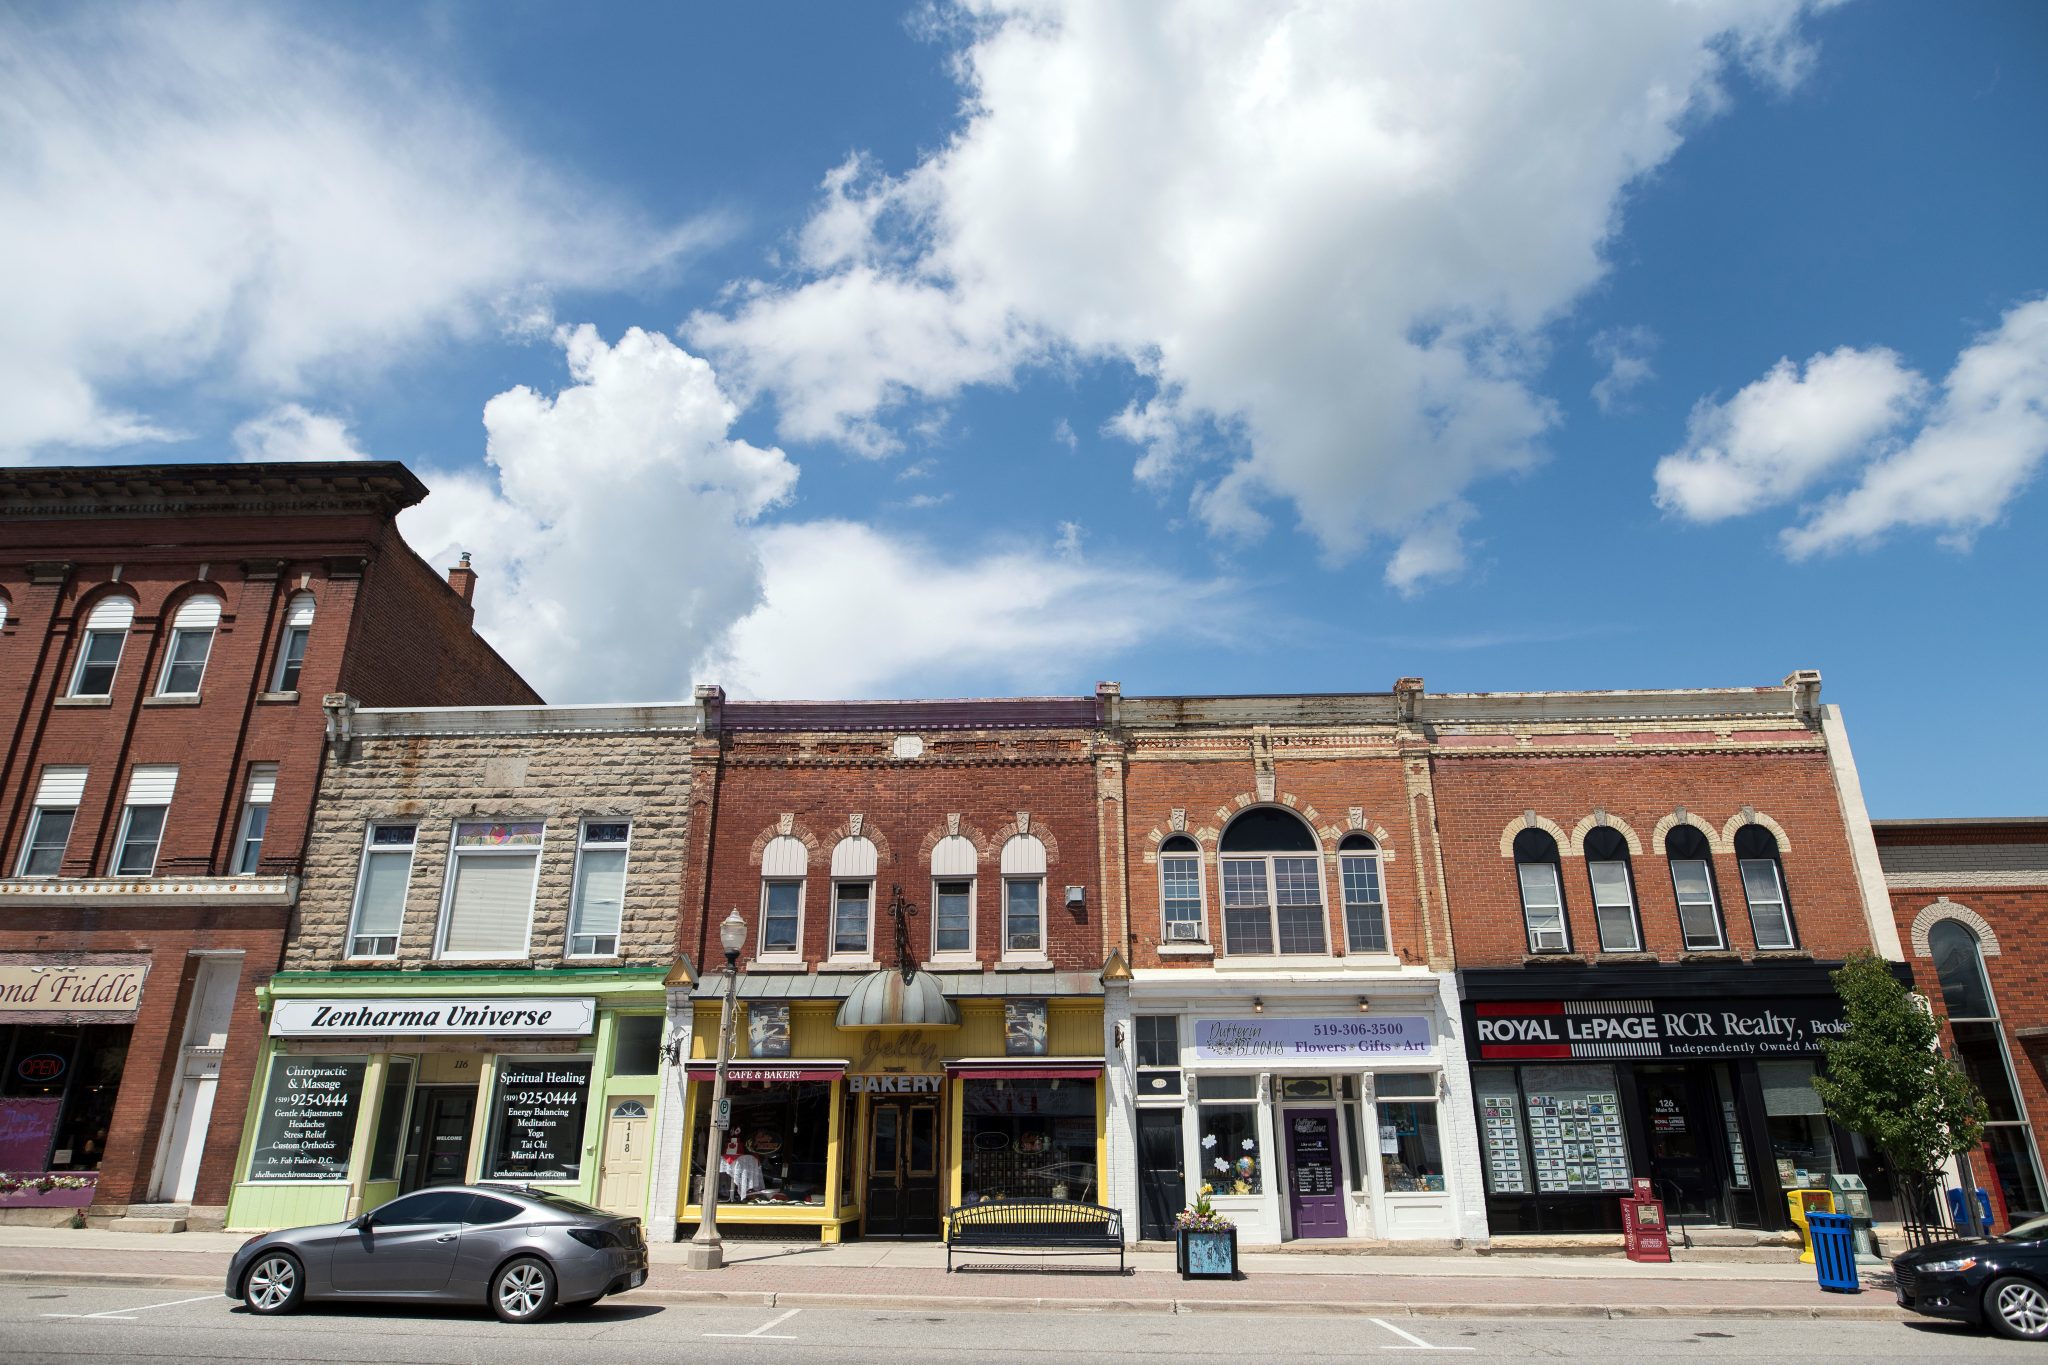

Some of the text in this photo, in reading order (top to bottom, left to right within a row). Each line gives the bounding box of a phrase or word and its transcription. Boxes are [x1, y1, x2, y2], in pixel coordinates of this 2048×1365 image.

[50, 973, 138, 1003] Fiddle
[311, 1004, 552, 1027] Zenharma Universe
[1314, 1022, 1404, 1036] 519-306-3500
[1477, 1018, 1559, 1041] ROYAL
[1566, 1017, 1659, 1040] LEPAGE
[1661, 1012, 1717, 1037] RCR
[1720, 1009, 1803, 1042] Realty,
[859, 1029, 939, 1072] Jelly
[1295, 1039, 1425, 1053] Flowers Gifts Art
[1670, 1042, 1755, 1055] Independently
[1759, 1041, 1800, 1052] Owned
[21, 1059, 60, 1075] OPEN
[454, 1060, 469, 1069] 116
[286, 1065, 348, 1078] Chiropractic
[754, 1070, 762, 1079] &
[764, 1070, 801, 1079] BAKERY
[500, 1071, 586, 1085] Spiritual Healing
[287, 1078, 341, 1091] & Massage
[849, 1075, 943, 1093] BAKERY
[274, 1093, 348, 1107] (519) 925-0444
[503, 1091, 578, 1105] (519) 925-0444
[1658, 1099, 1675, 1107] 126
[274, 1108, 343, 1118] Gentle Adjustments
[507, 1107, 570, 1117] Energy Balancing
[288, 1120, 325, 1128] Headaches
[517, 1118, 557, 1127] Meditation
[283, 1130, 327, 1139] Stress Relief
[527, 1128, 544, 1138] Yoga
[272, 1140, 336, 1149] Custom Orthotics
[520, 1140, 548, 1149] Tai Chi
[510, 1150, 555, 1160] Martial Arts
[267, 1156, 279, 1165] Dr.
[317, 1156, 334, 1165] D.C.
[255, 1170, 342, 1180] shelburnechiromassage.com
[493, 1169, 567, 1178] zenharmauniverse.com
